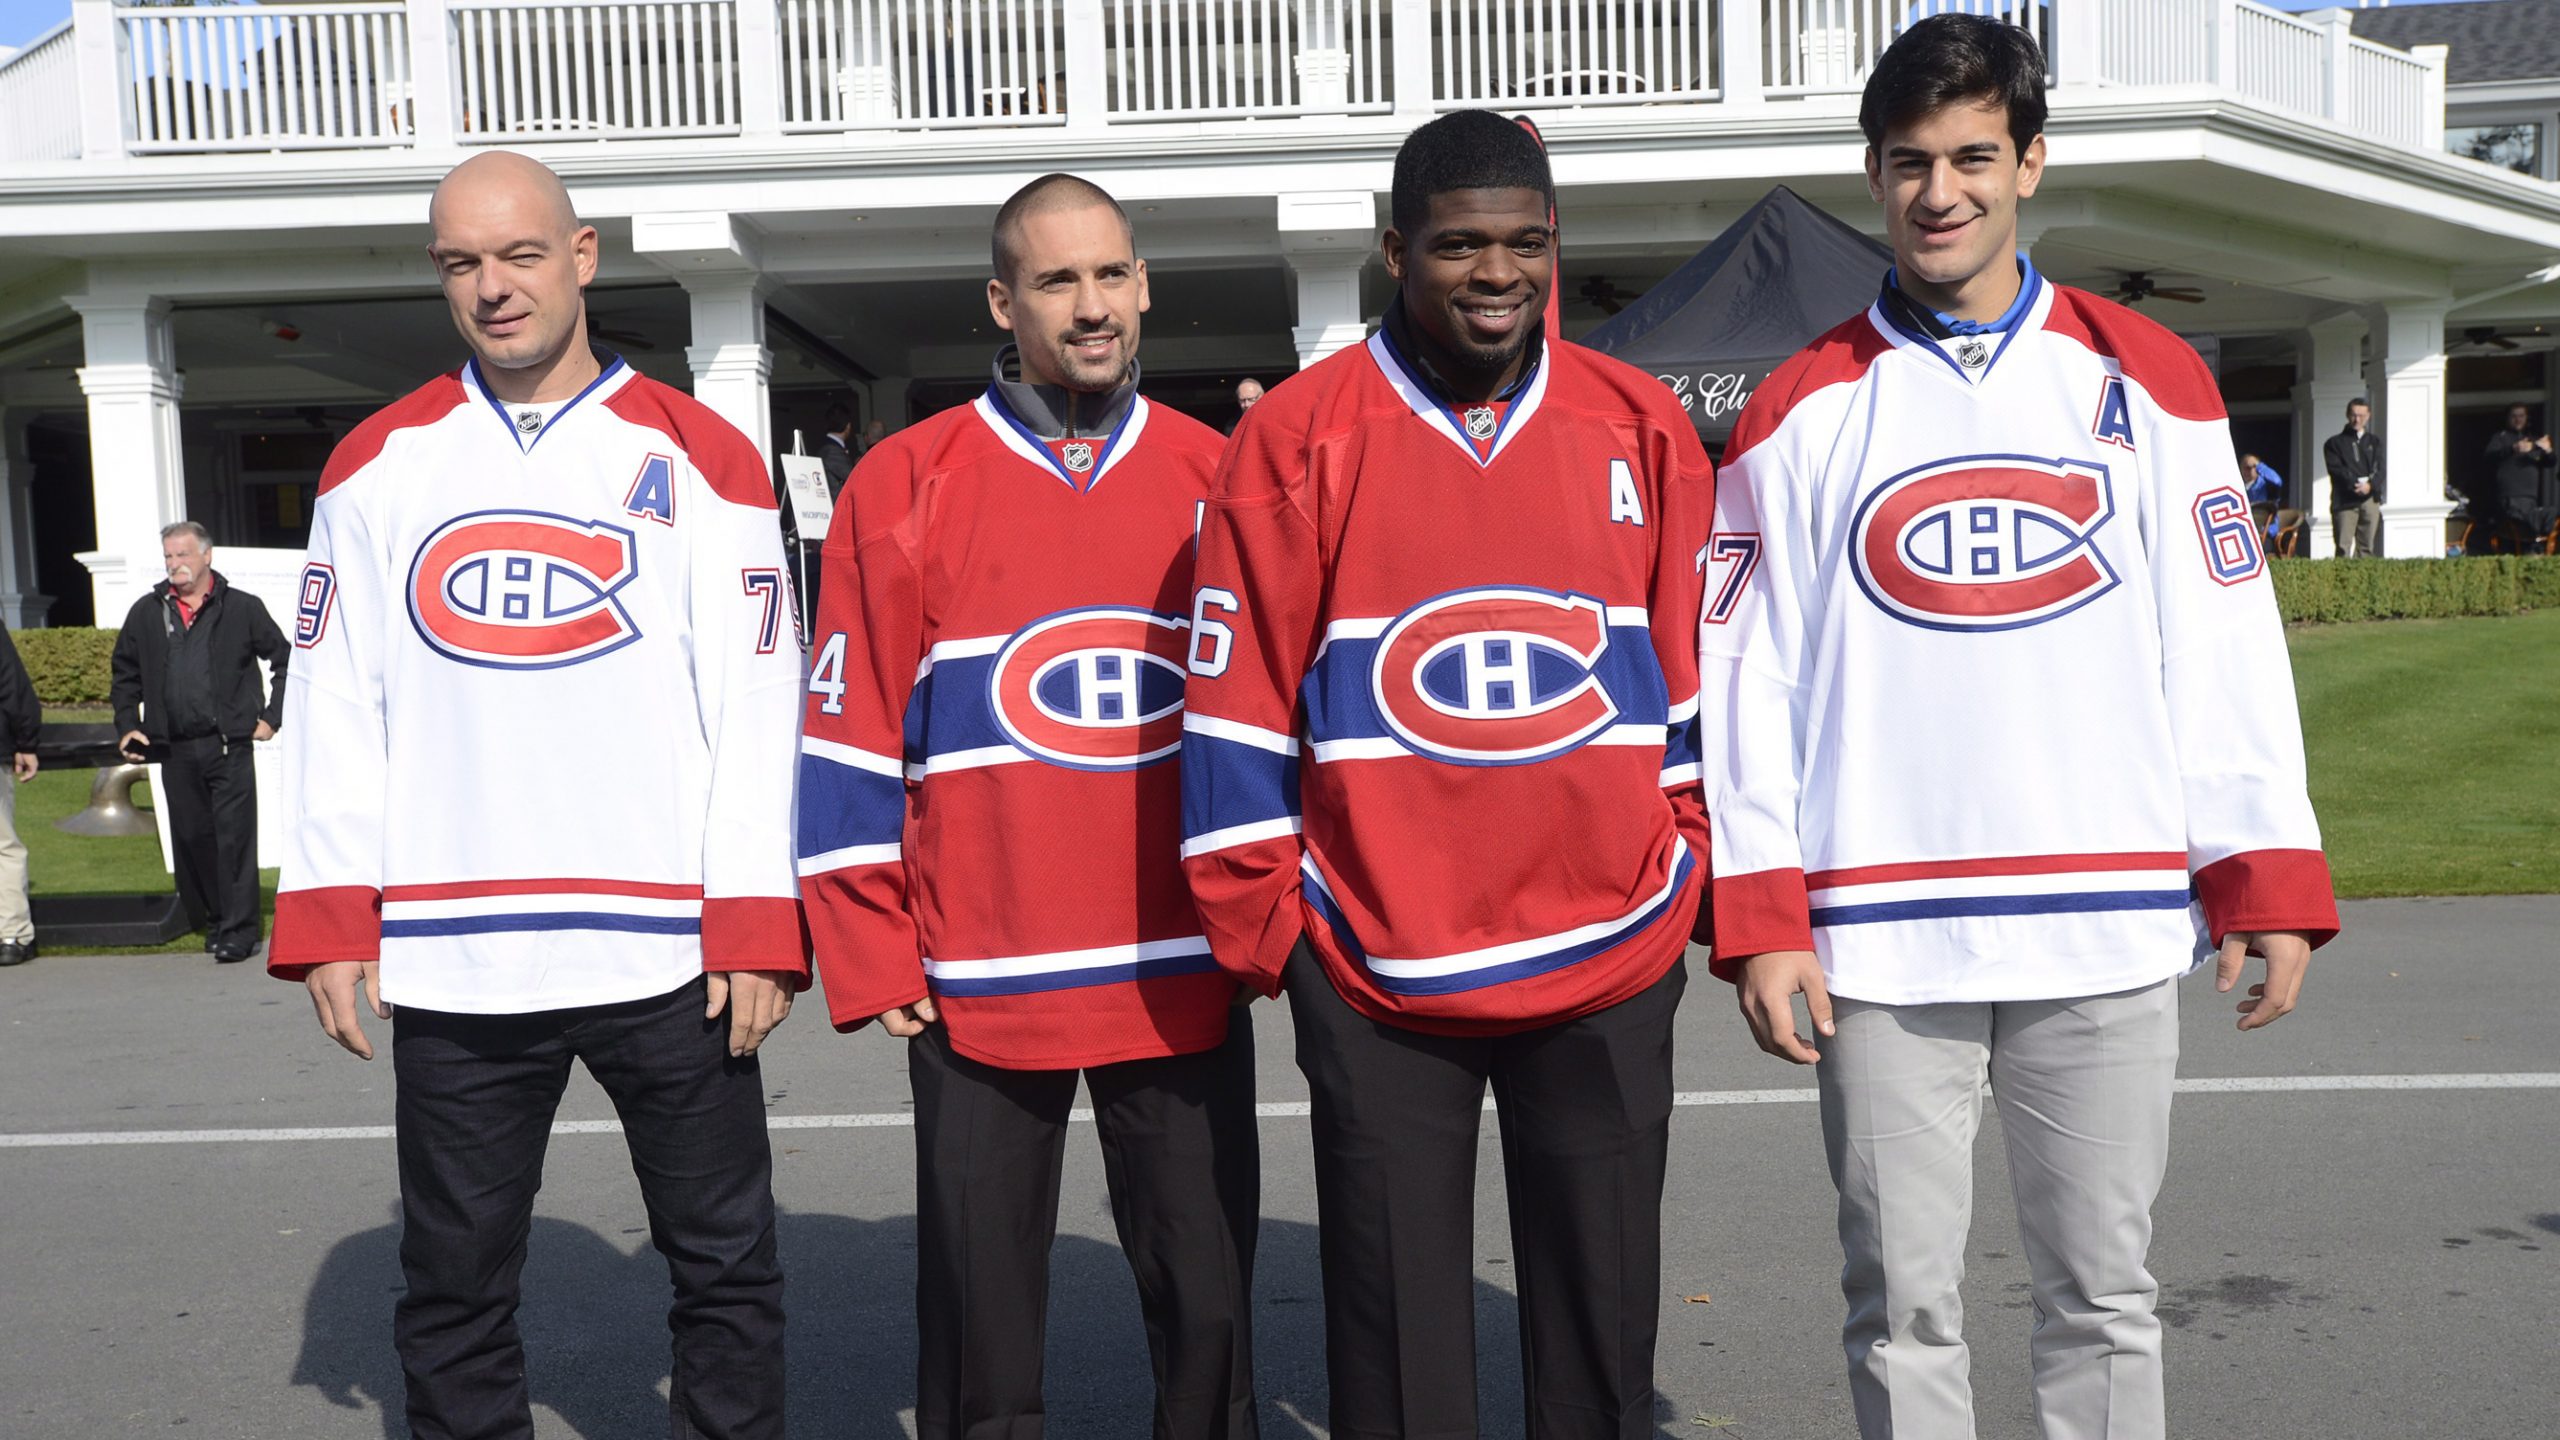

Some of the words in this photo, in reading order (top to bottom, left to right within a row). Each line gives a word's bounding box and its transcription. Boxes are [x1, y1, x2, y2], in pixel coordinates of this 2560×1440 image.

[2091, 375, 2136, 453] A
[622, 452, 676, 528] A
[1609, 458, 1645, 528] A
[1704, 532, 1763, 625] 7
[2191, 485, 2265, 587] 6
[295, 562, 337, 650] 9
[1187, 586, 1240, 680] 6
[808, 631, 849, 717] 4
